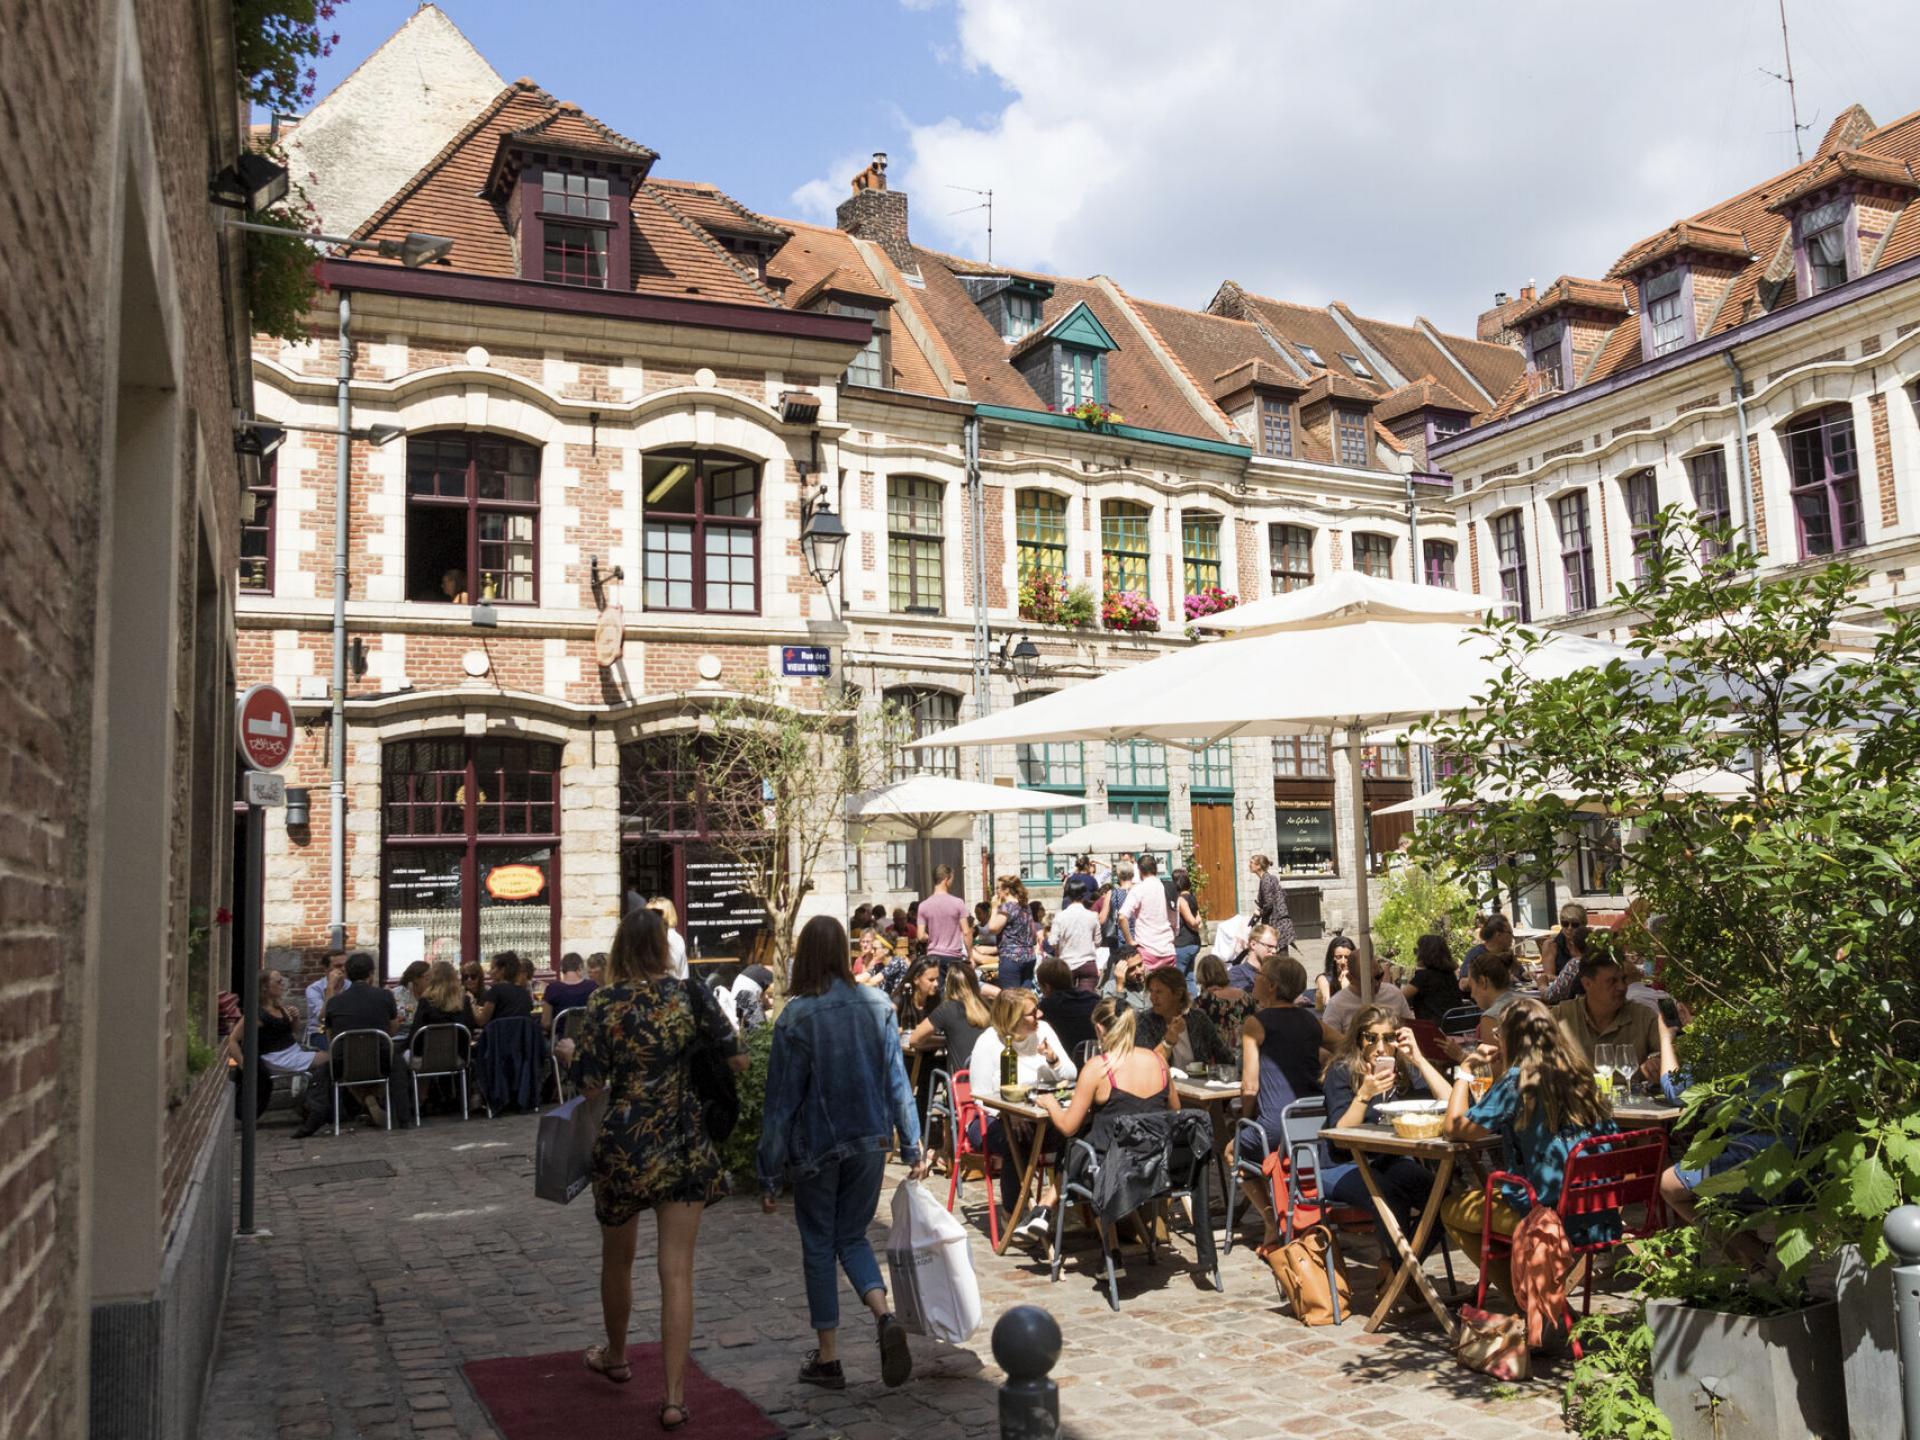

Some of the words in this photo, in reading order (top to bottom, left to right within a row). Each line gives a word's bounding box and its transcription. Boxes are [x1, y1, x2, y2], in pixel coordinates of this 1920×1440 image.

[801, 651, 813, 660] Rue
[815, 652, 826, 660] des
[786, 663, 806, 672] VIEUX
[807, 663, 826, 672] MURS
